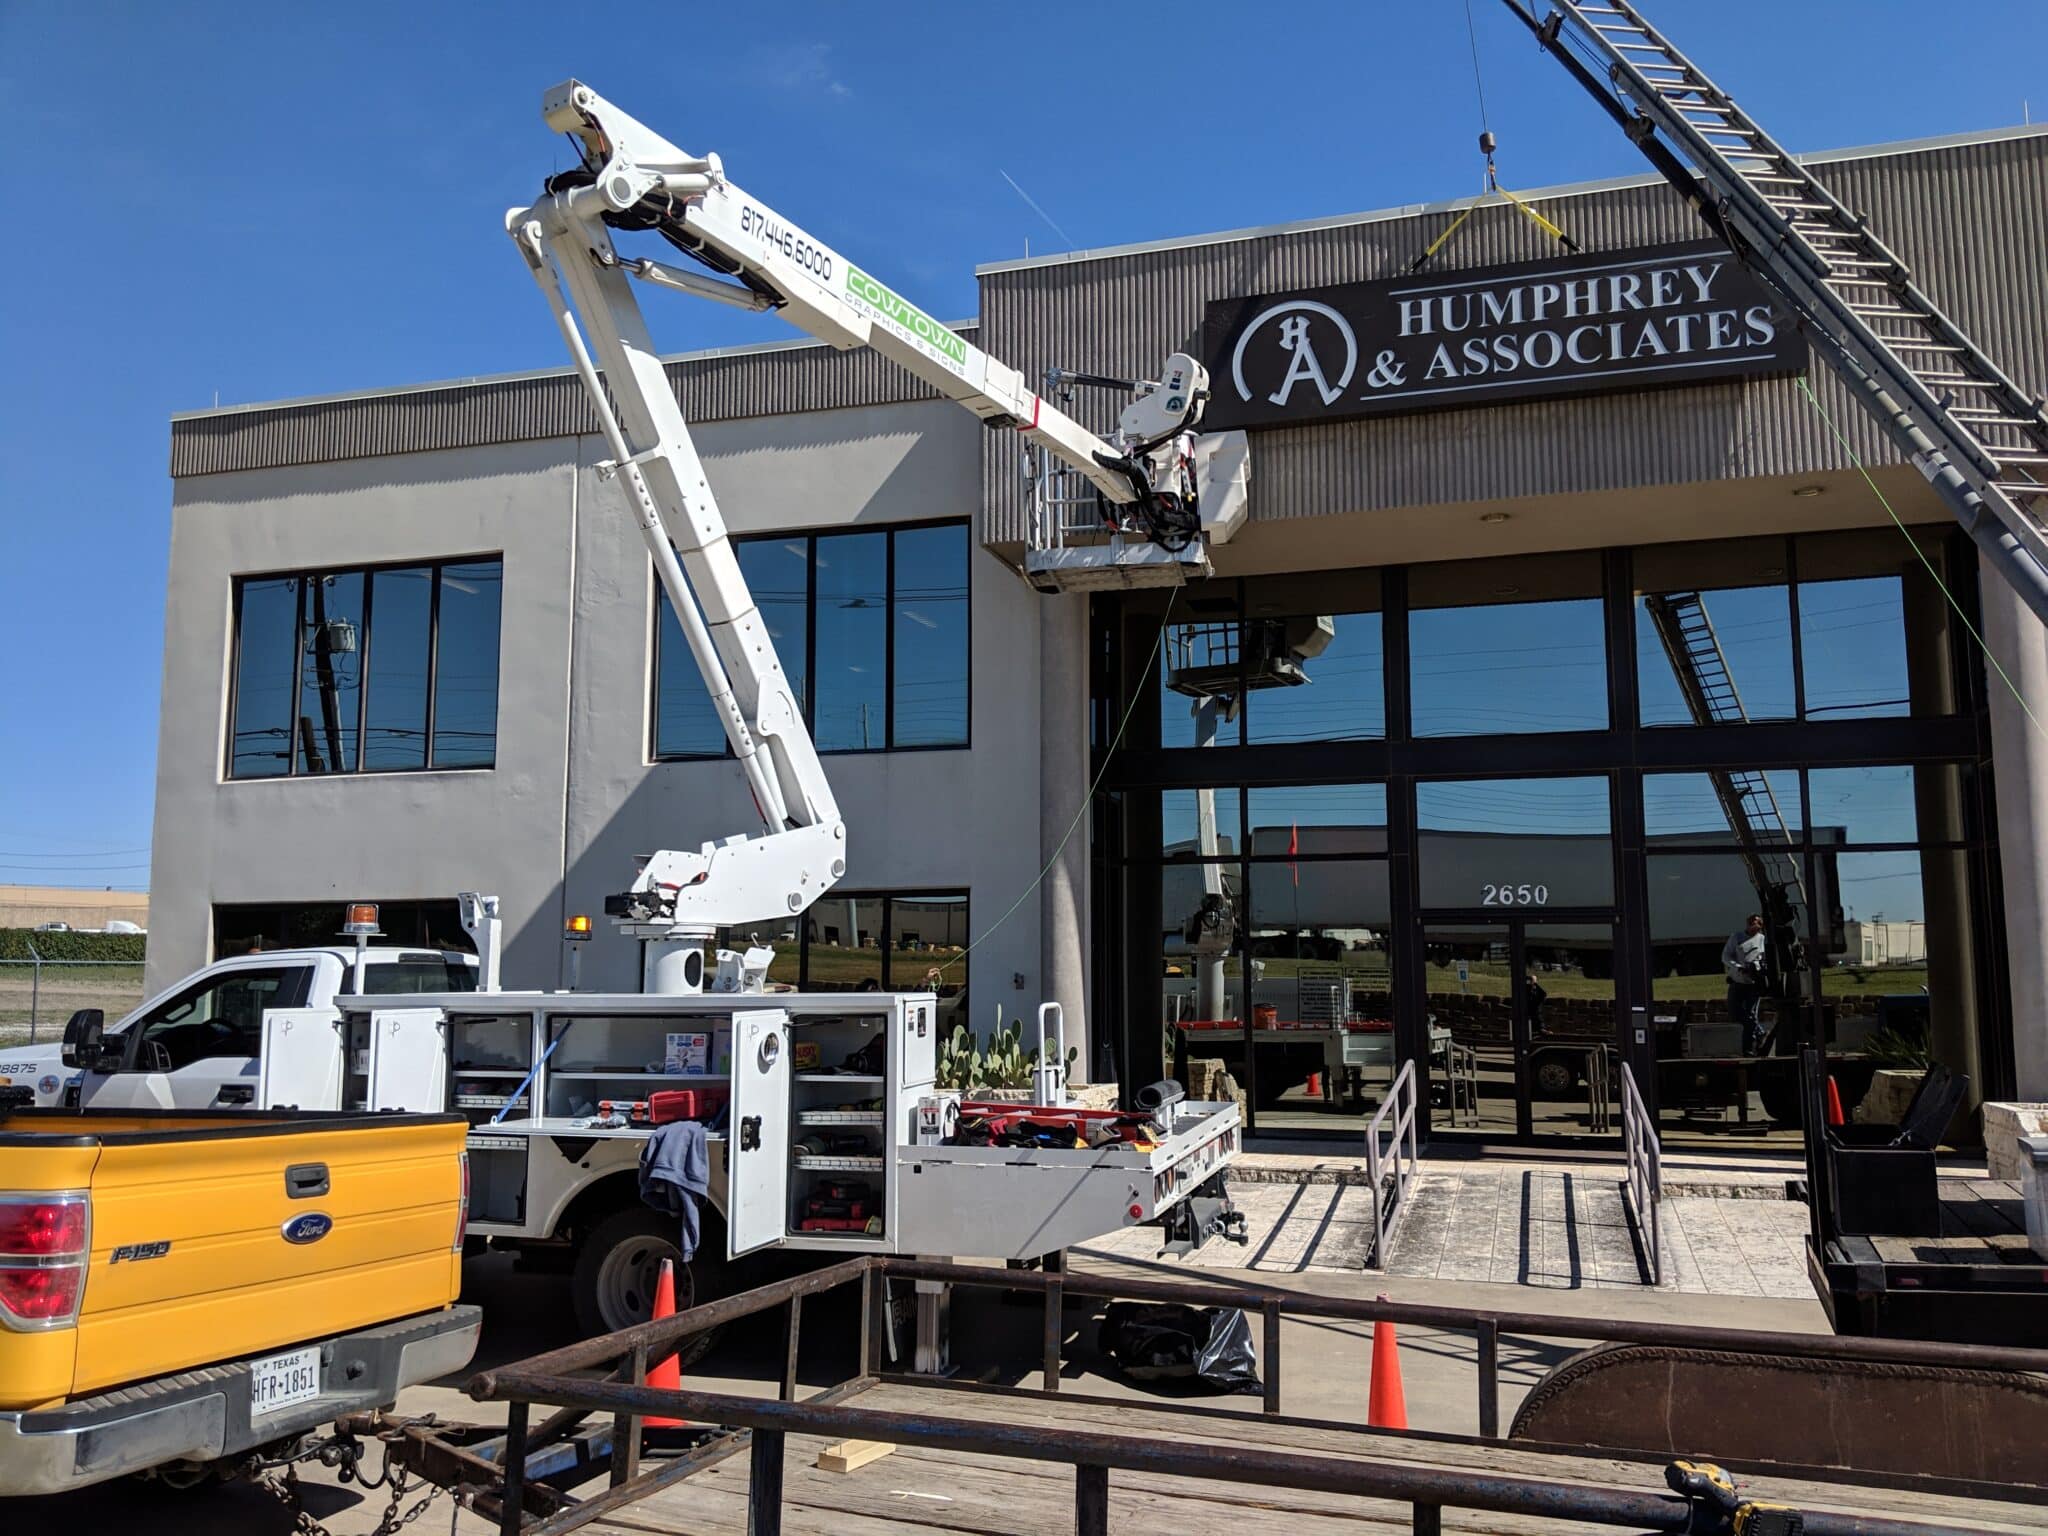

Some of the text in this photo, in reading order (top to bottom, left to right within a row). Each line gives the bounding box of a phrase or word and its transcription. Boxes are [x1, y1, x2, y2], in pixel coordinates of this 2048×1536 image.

[741, 206, 832, 281] 817.446.6000
[845, 292, 911, 342] GRAPHICS
[929, 348, 965, 376] SIGNS
[849, 271, 966, 361] COWTOWN
[1396, 263, 1723, 337] HUMPHREY
[1367, 305, 1776, 388] & ASSOCIATES
[1482, 884, 1548, 905] 2650
[109, 1240, 171, 1264] F-150
[297, 1218, 326, 1238] Ford
[273, 1356, 300, 1370] TEXAS
